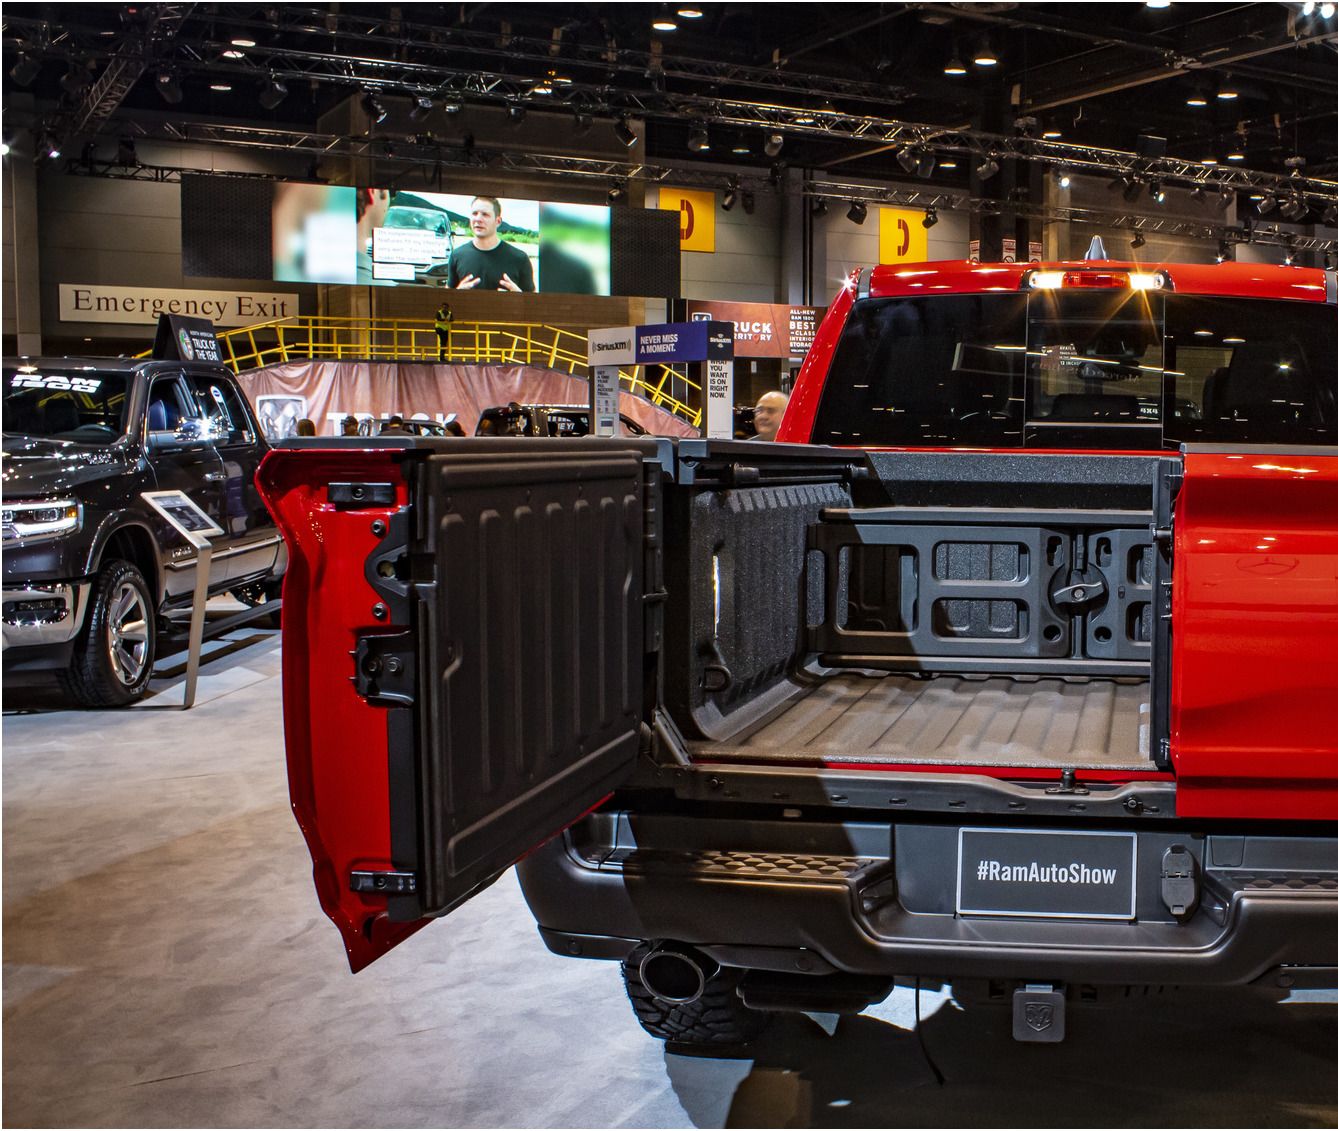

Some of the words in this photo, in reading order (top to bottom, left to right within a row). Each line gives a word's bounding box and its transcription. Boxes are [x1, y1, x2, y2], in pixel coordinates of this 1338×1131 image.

[73, 289, 228, 321] Emergency
[236, 296, 288, 317] Exit
[734, 321, 772, 334] RUCK
[789, 321, 816, 330] BEST
[192, 337, 209, 349] TRUCK
[640, 335, 661, 345] NEVER
[662, 334, 678, 344] MISS
[647, 344, 676, 353] MOMENT.
[205, 351, 219, 361] YEAR
[12, 374, 102, 388] RAM
[977, 860, 1117, 885] #RamAutoShow
